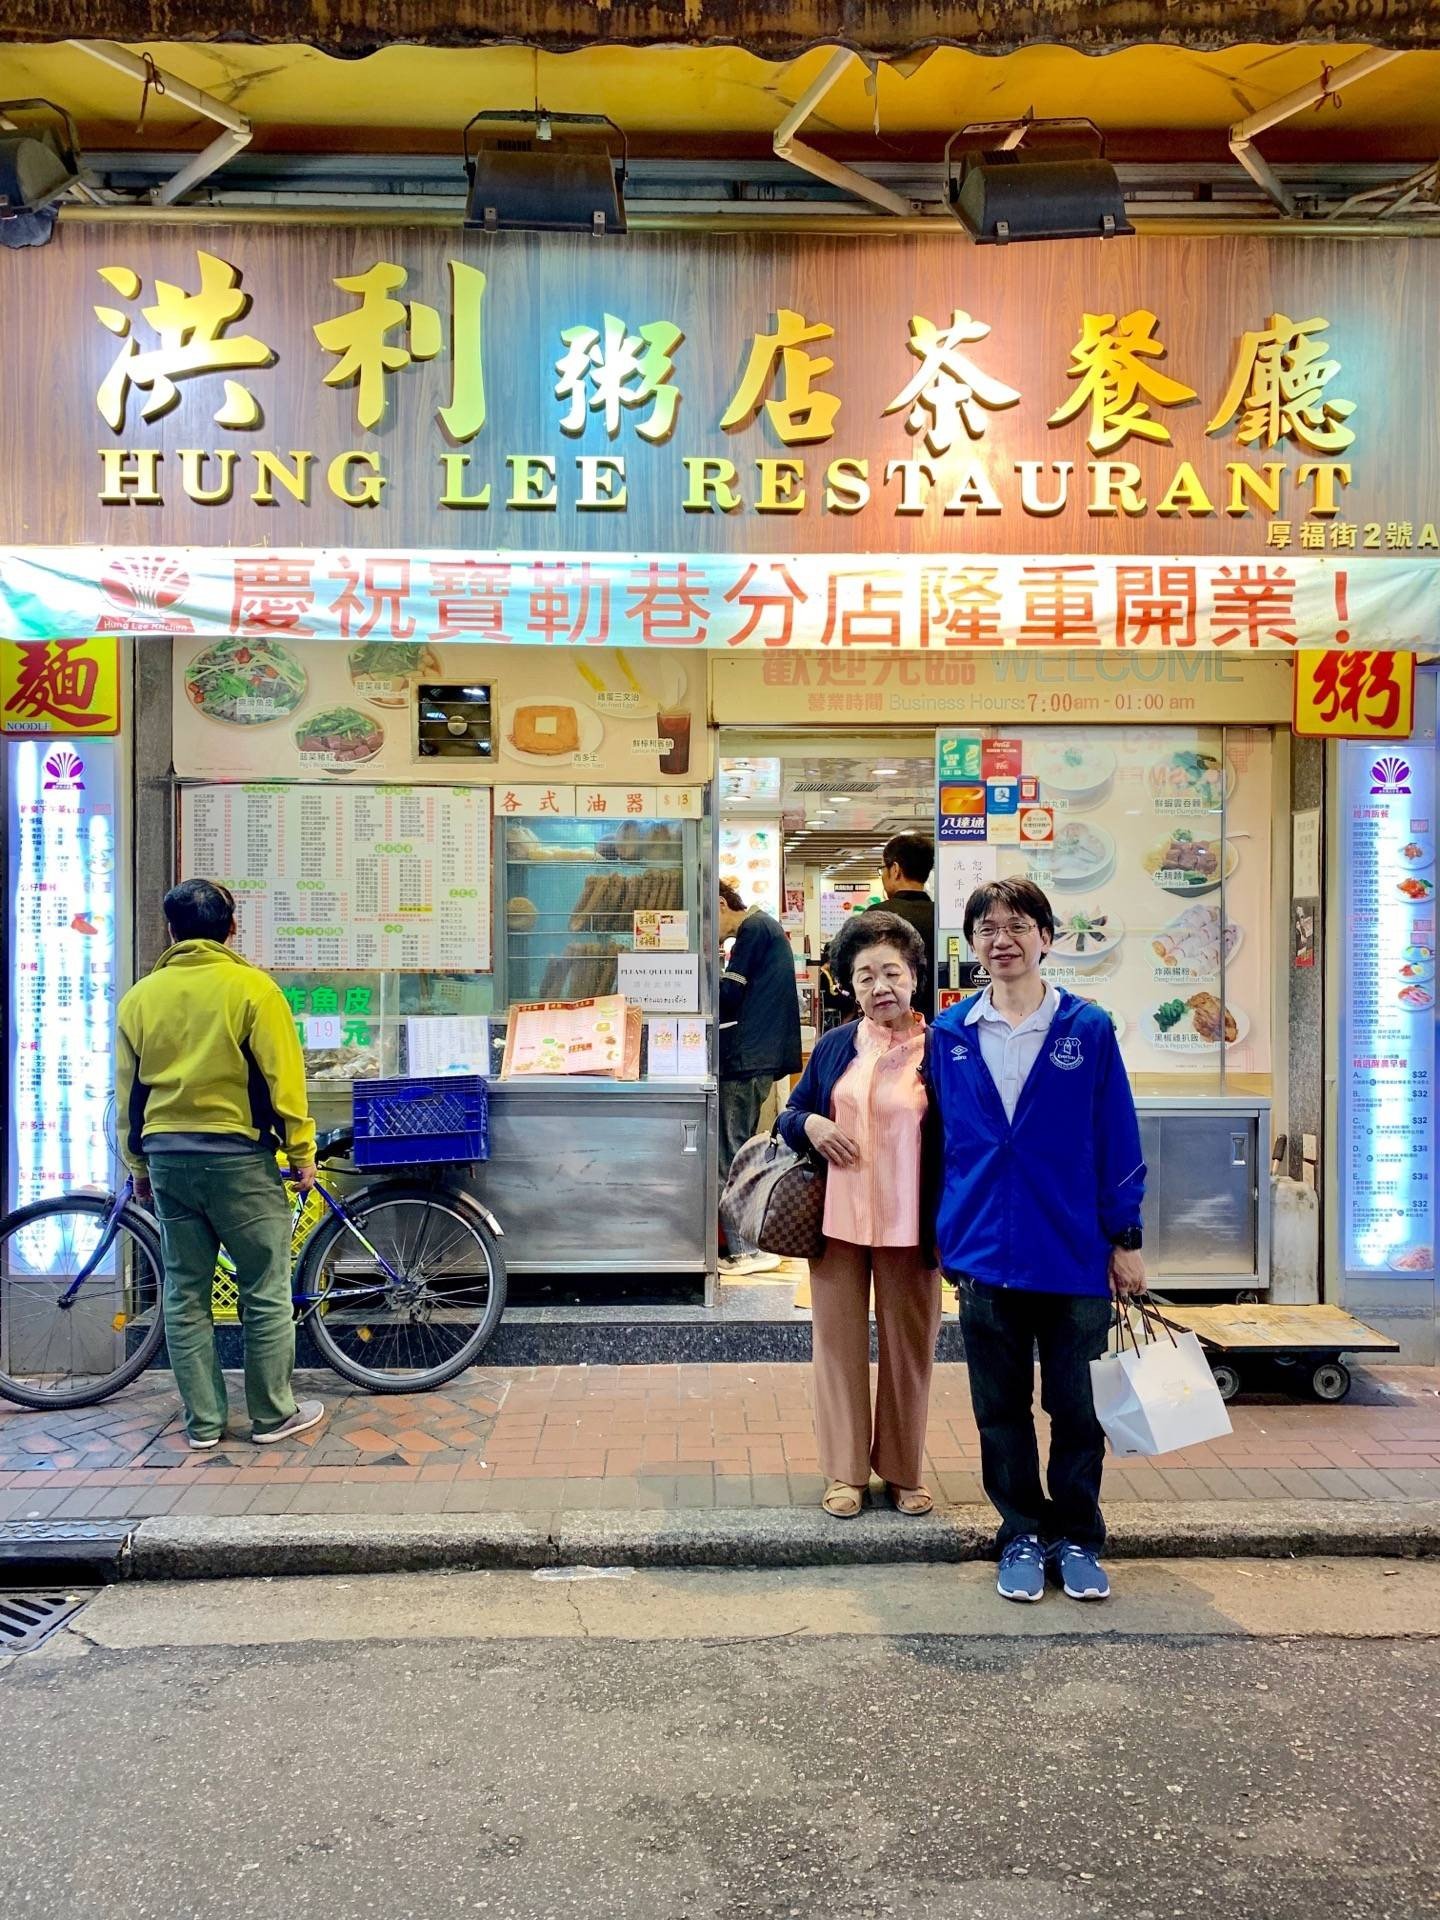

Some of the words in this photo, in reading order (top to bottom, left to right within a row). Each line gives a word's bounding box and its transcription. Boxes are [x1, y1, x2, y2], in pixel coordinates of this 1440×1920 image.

[94, 250, 1358, 455] 洪利粥店茶餐廳
[98, 448, 387, 507] HUNG
[439, 453, 627, 510] LEE
[683, 456, 1353, 516] RESTAURANT
[104, 620, 129, 630] Hung
[131, 622, 151, 630] Lee
[762, 650, 976, 686] 歡迎光臨
[991, 650, 1244, 683] WELCOME
[1313, 651, 1400, 729] 粥
[889, 693, 966, 711] Business
[1115, 693, 1164, 711] 01:00
[1169, 696, 1195, 710] am
[501, 790, 643, 813] 各式油器
[941, 817, 985, 829] 八達通
[314, 1020, 334, 1038] 19
[1412, 1070, 1428, 1078] $32
[1412, 1090, 1428, 1098] $32
